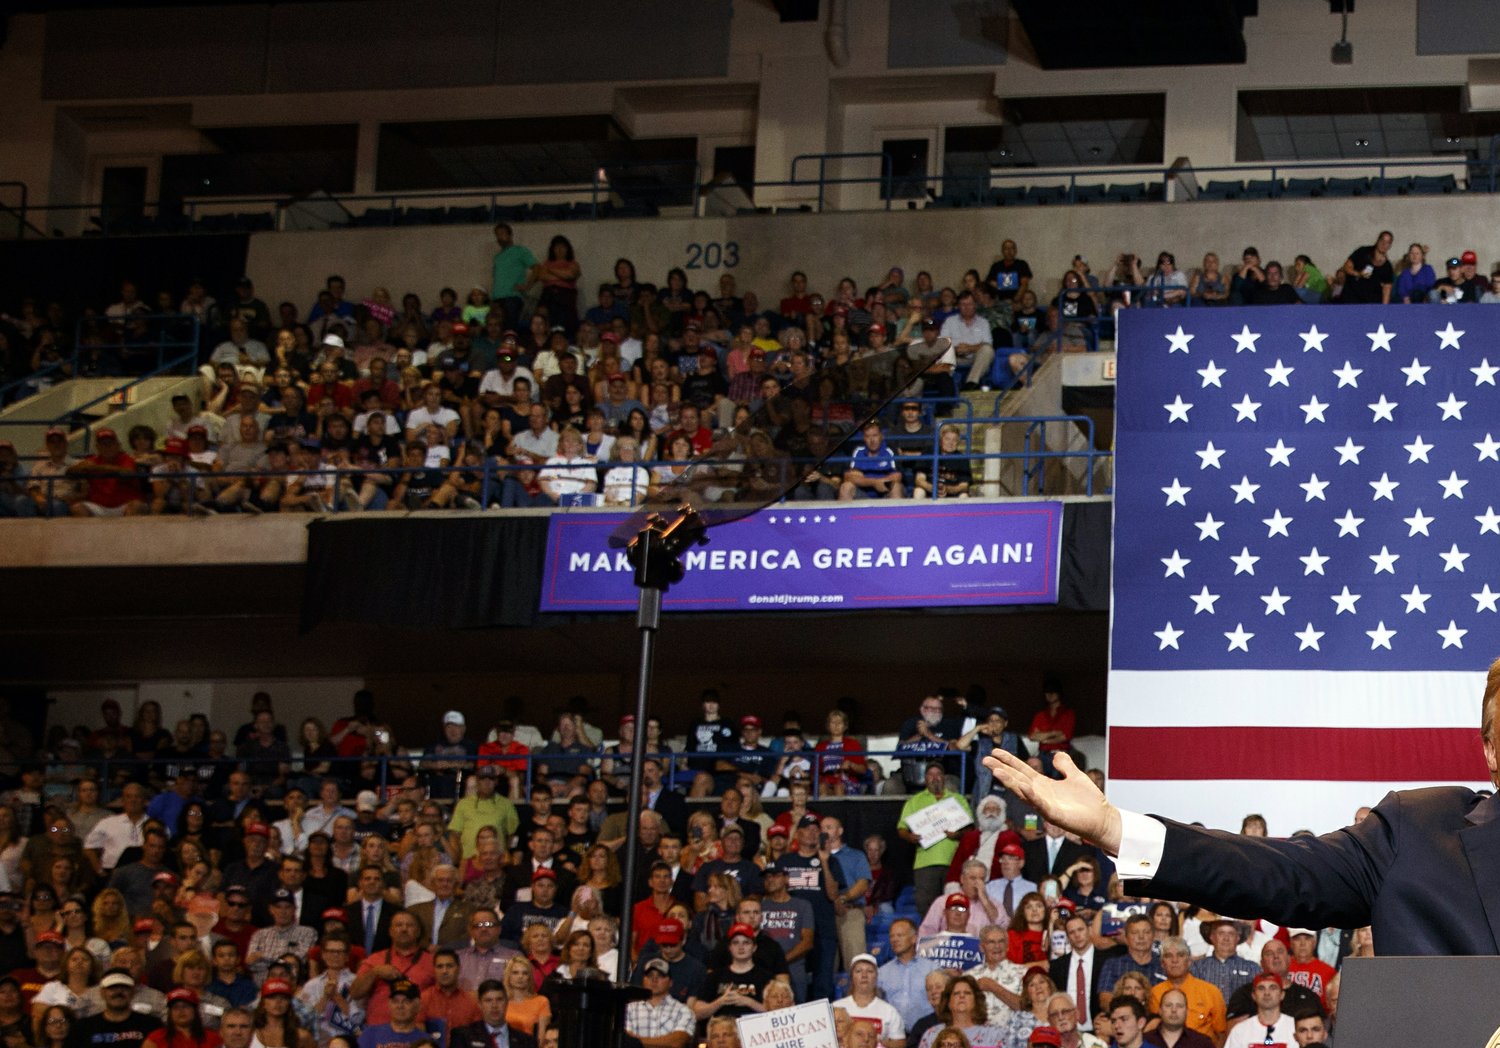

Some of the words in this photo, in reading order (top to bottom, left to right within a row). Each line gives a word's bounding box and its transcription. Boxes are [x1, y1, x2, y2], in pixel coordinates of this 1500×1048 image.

[686, 242, 740, 269] 203
[569, 551, 633, 572] MAK
[685, 548, 802, 571] MERICA
[812, 546, 914, 569] GREAT
[923, 542, 1034, 567] AGAIN!
[748, 593, 844, 605] donaldjtrump.com
[938, 940, 965, 948] KEEP
[919, 948, 983, 963] AMERICA
[771, 1013, 797, 1028] BUY
[748, 1017, 828, 1048] AMERICAN
